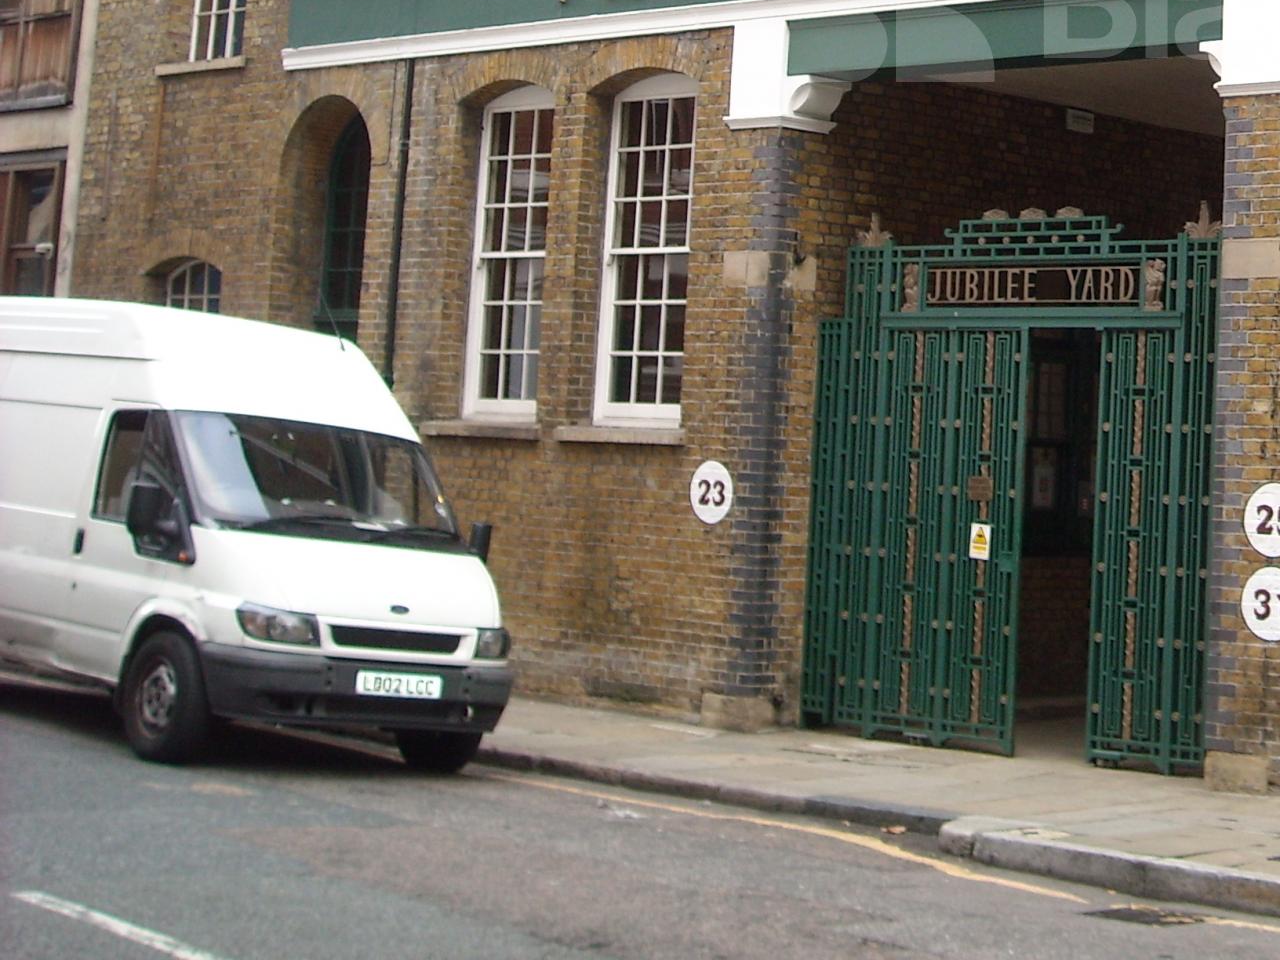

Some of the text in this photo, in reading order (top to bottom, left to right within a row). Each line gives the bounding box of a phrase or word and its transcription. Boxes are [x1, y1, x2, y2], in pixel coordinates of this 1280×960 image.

[926, 267, 1136, 303] JUBILEE YARD
[698, 479, 726, 507] 23
